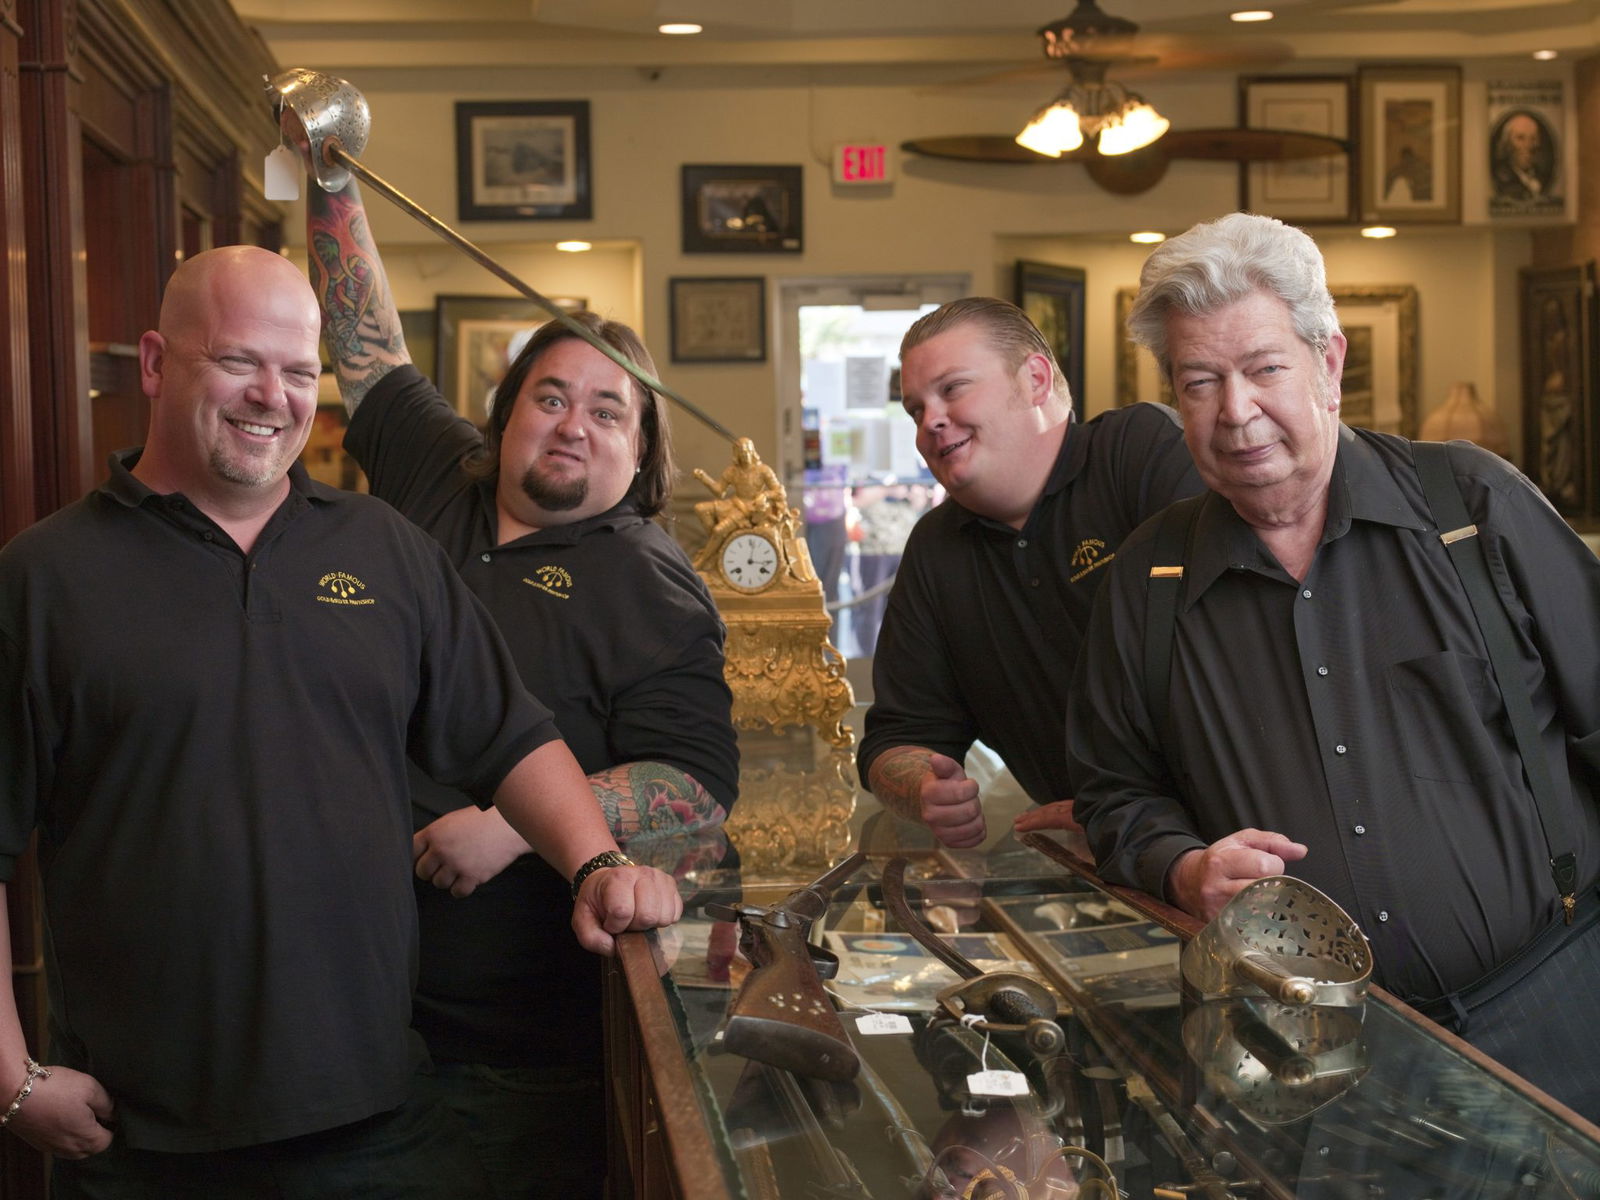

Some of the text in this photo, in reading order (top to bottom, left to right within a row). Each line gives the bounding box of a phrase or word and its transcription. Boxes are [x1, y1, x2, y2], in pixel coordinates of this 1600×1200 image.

[843, 145, 885, 180] EXIT
[318, 571, 366, 590] WORLD FAMOUS
